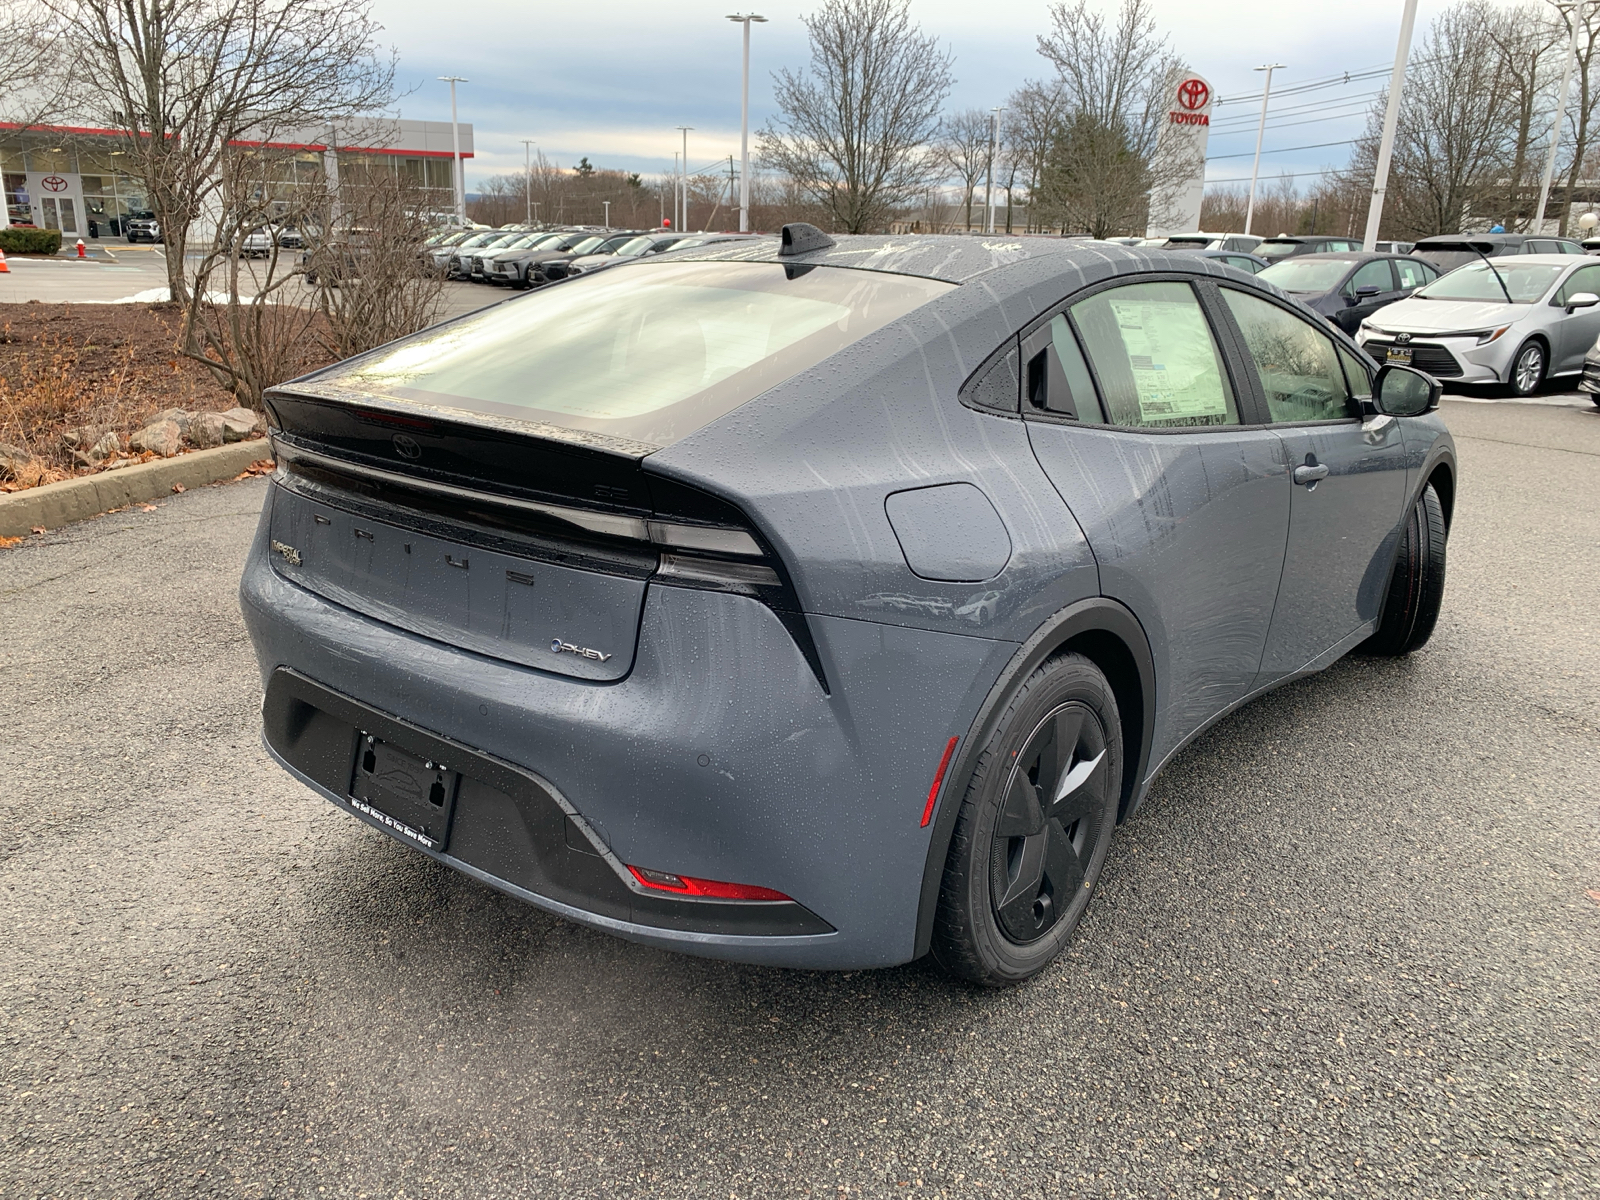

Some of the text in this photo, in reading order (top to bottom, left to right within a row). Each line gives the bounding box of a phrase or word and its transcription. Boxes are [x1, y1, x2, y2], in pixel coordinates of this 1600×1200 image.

[1169, 111, 1209, 126] TOYOTA
[594, 484, 630, 500] SE
[314, 514, 534, 586] PRIUS
[561, 642, 612, 662] PHEV
[351, 798, 432, 848] We Sell More, So You Save More
